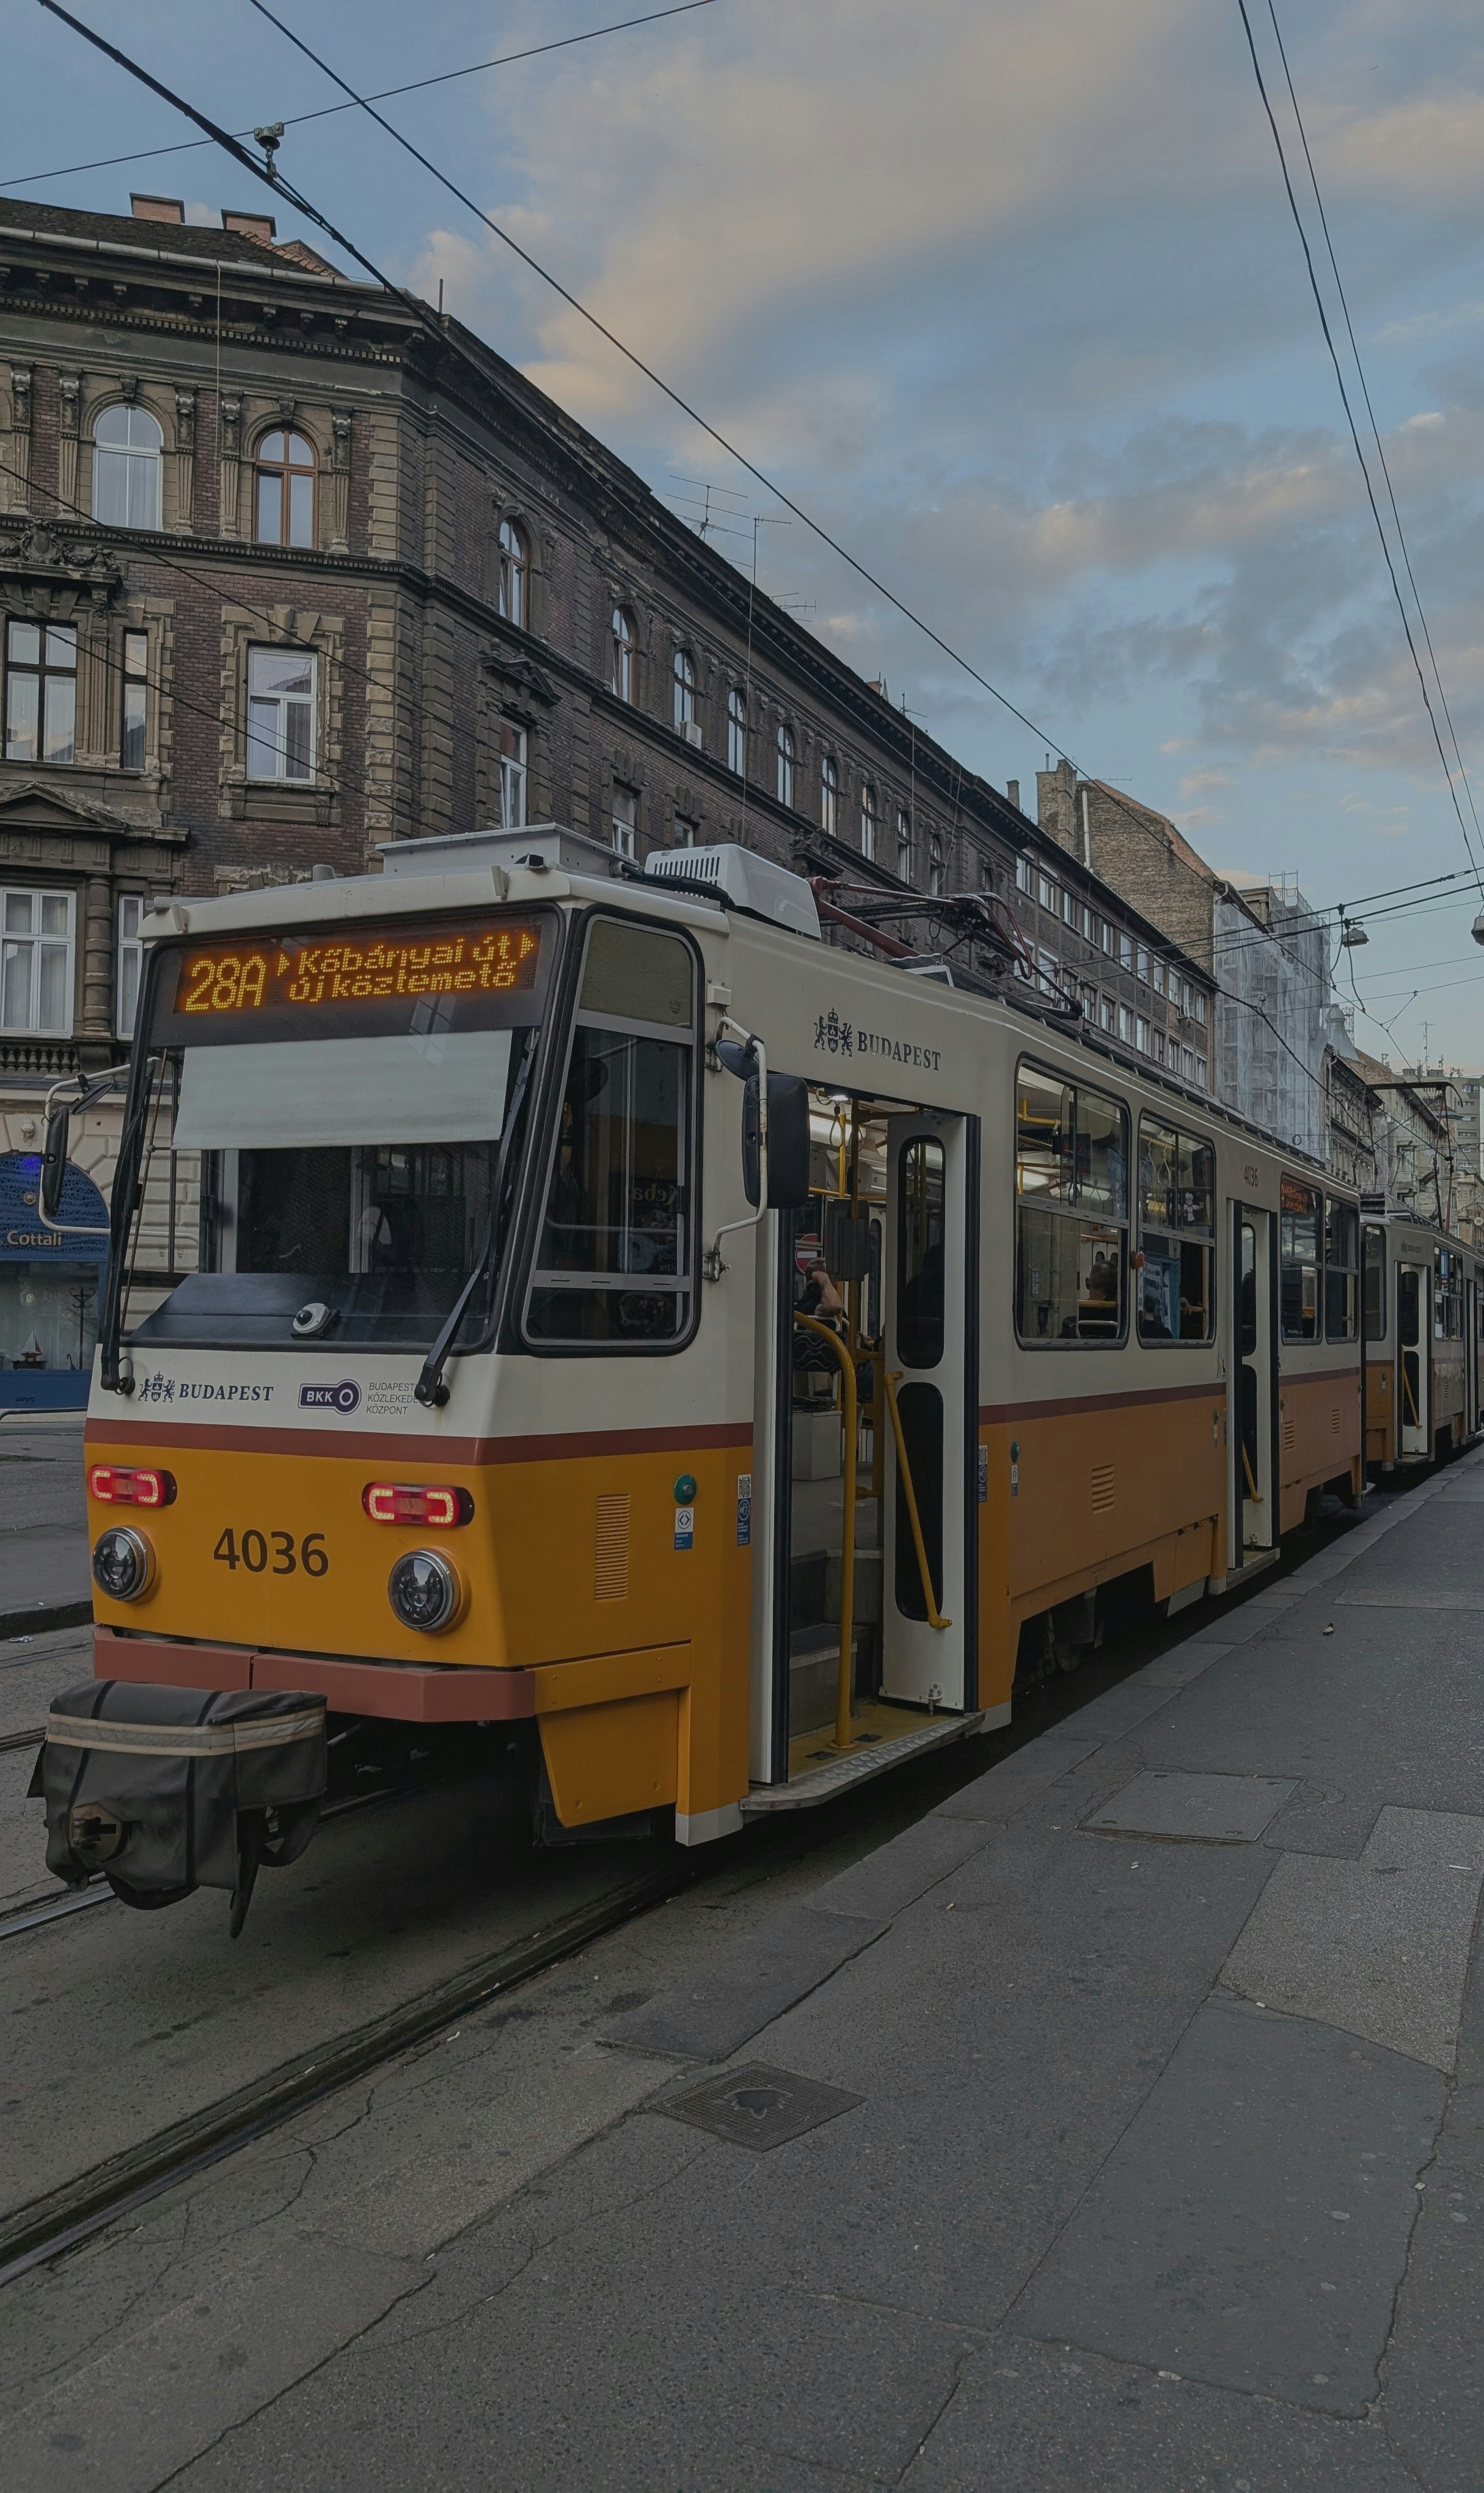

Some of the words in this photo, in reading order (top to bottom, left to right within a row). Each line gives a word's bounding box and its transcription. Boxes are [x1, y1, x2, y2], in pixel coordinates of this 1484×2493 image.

[185, 956, 266, 1011] 28A
[857, 1031, 941, 1071] BUDAPEST
[1244, 1165, 1258, 1188] 4036
[7, 1230, 62, 1246] Cottali
[178, 1383, 274, 1401] BUDAPEST
[369, 1382, 417, 1391] BUDAPEST
[306, 1391, 334, 1403] BKK
[367, 1404, 409, 1415] KÖZPONT
[213, 1528, 329, 1577] 4036
